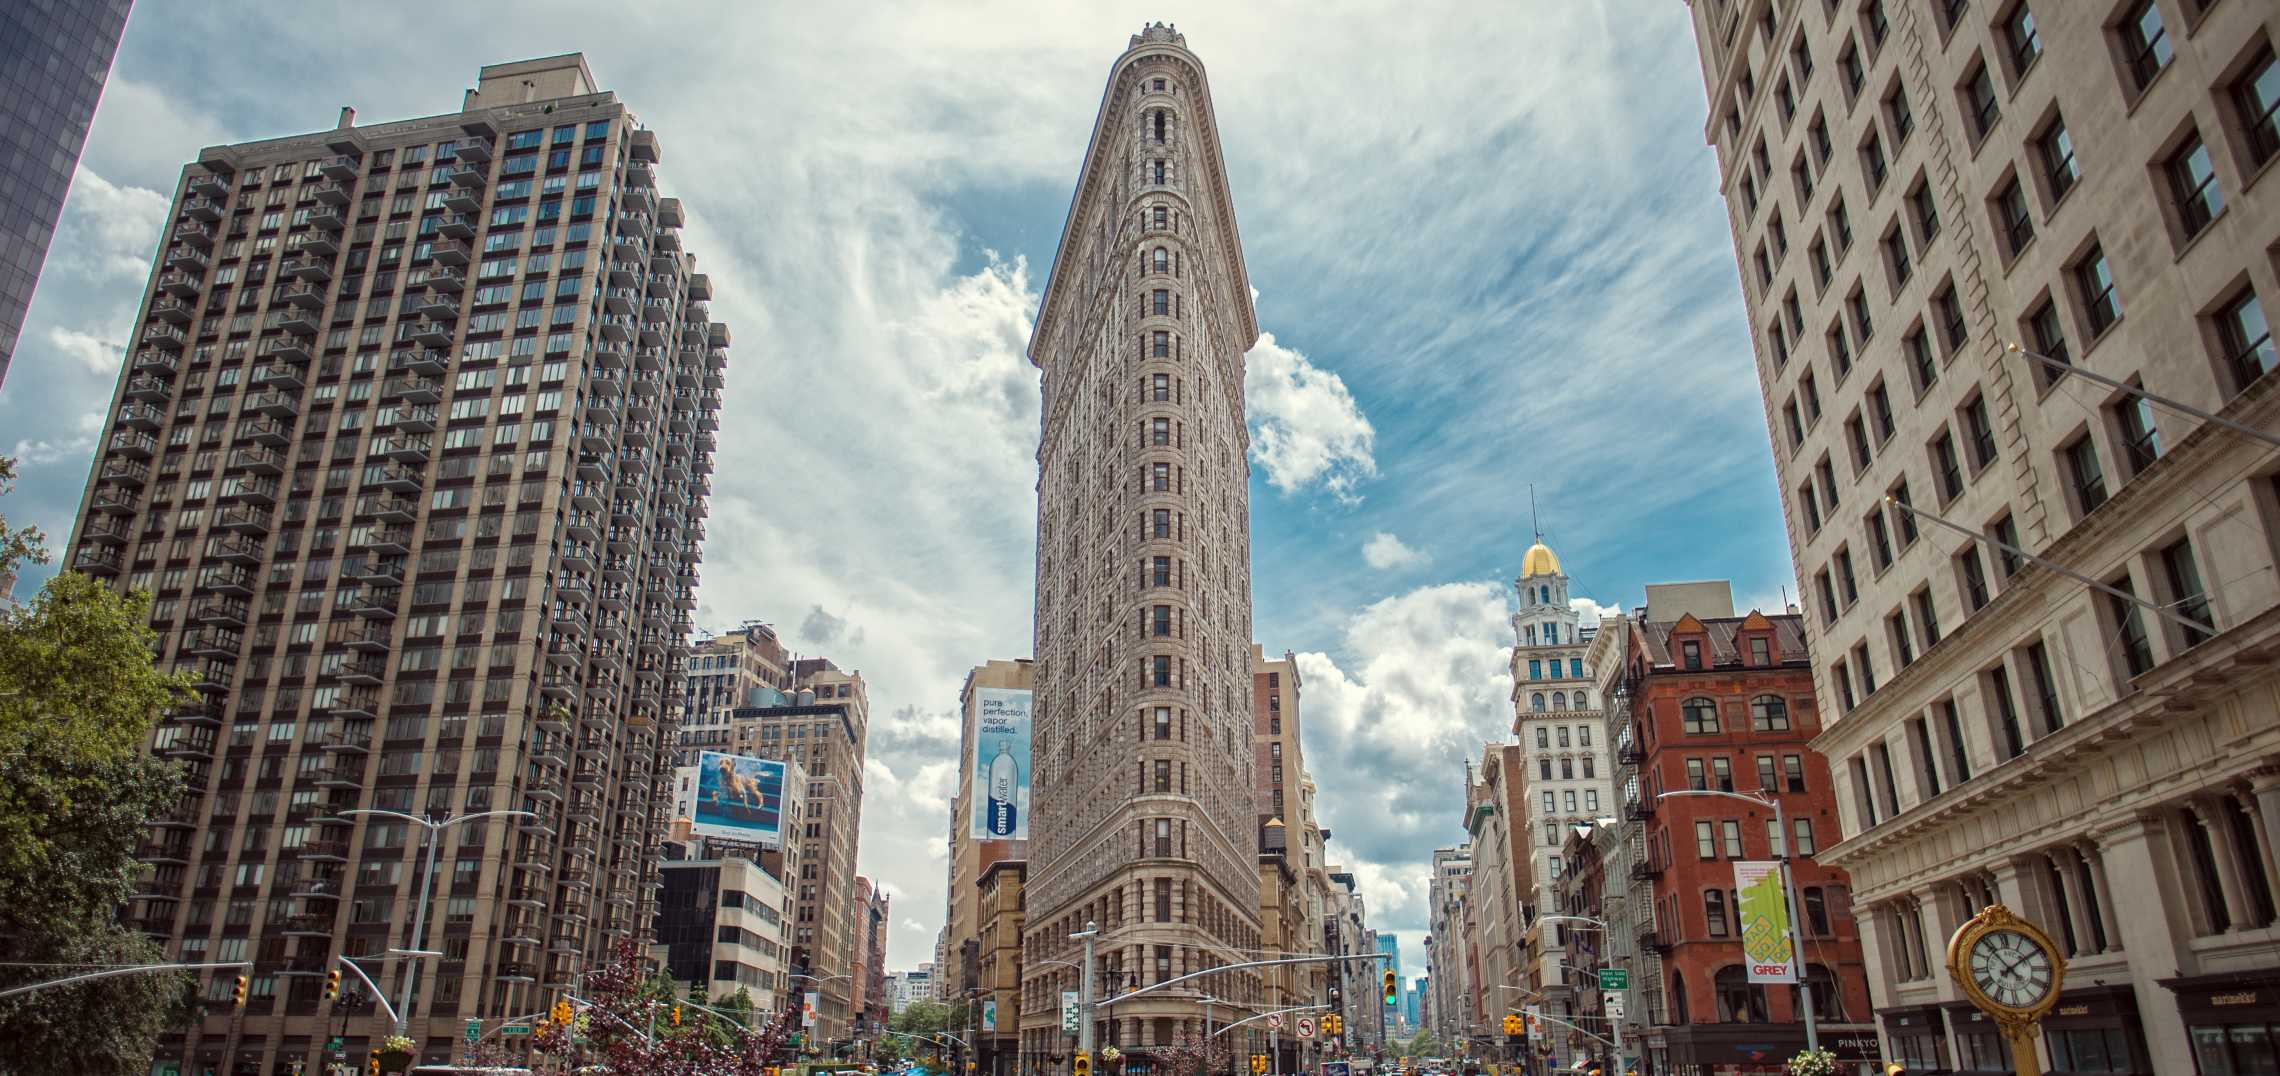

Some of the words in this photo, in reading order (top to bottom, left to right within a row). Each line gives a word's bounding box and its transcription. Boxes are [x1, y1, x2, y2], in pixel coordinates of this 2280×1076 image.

[983, 699, 1003, 708] pure
[983, 717, 1007, 726] vapor
[996, 777, 1009, 835] smartwater
[1752, 964, 1788, 976] GREY
